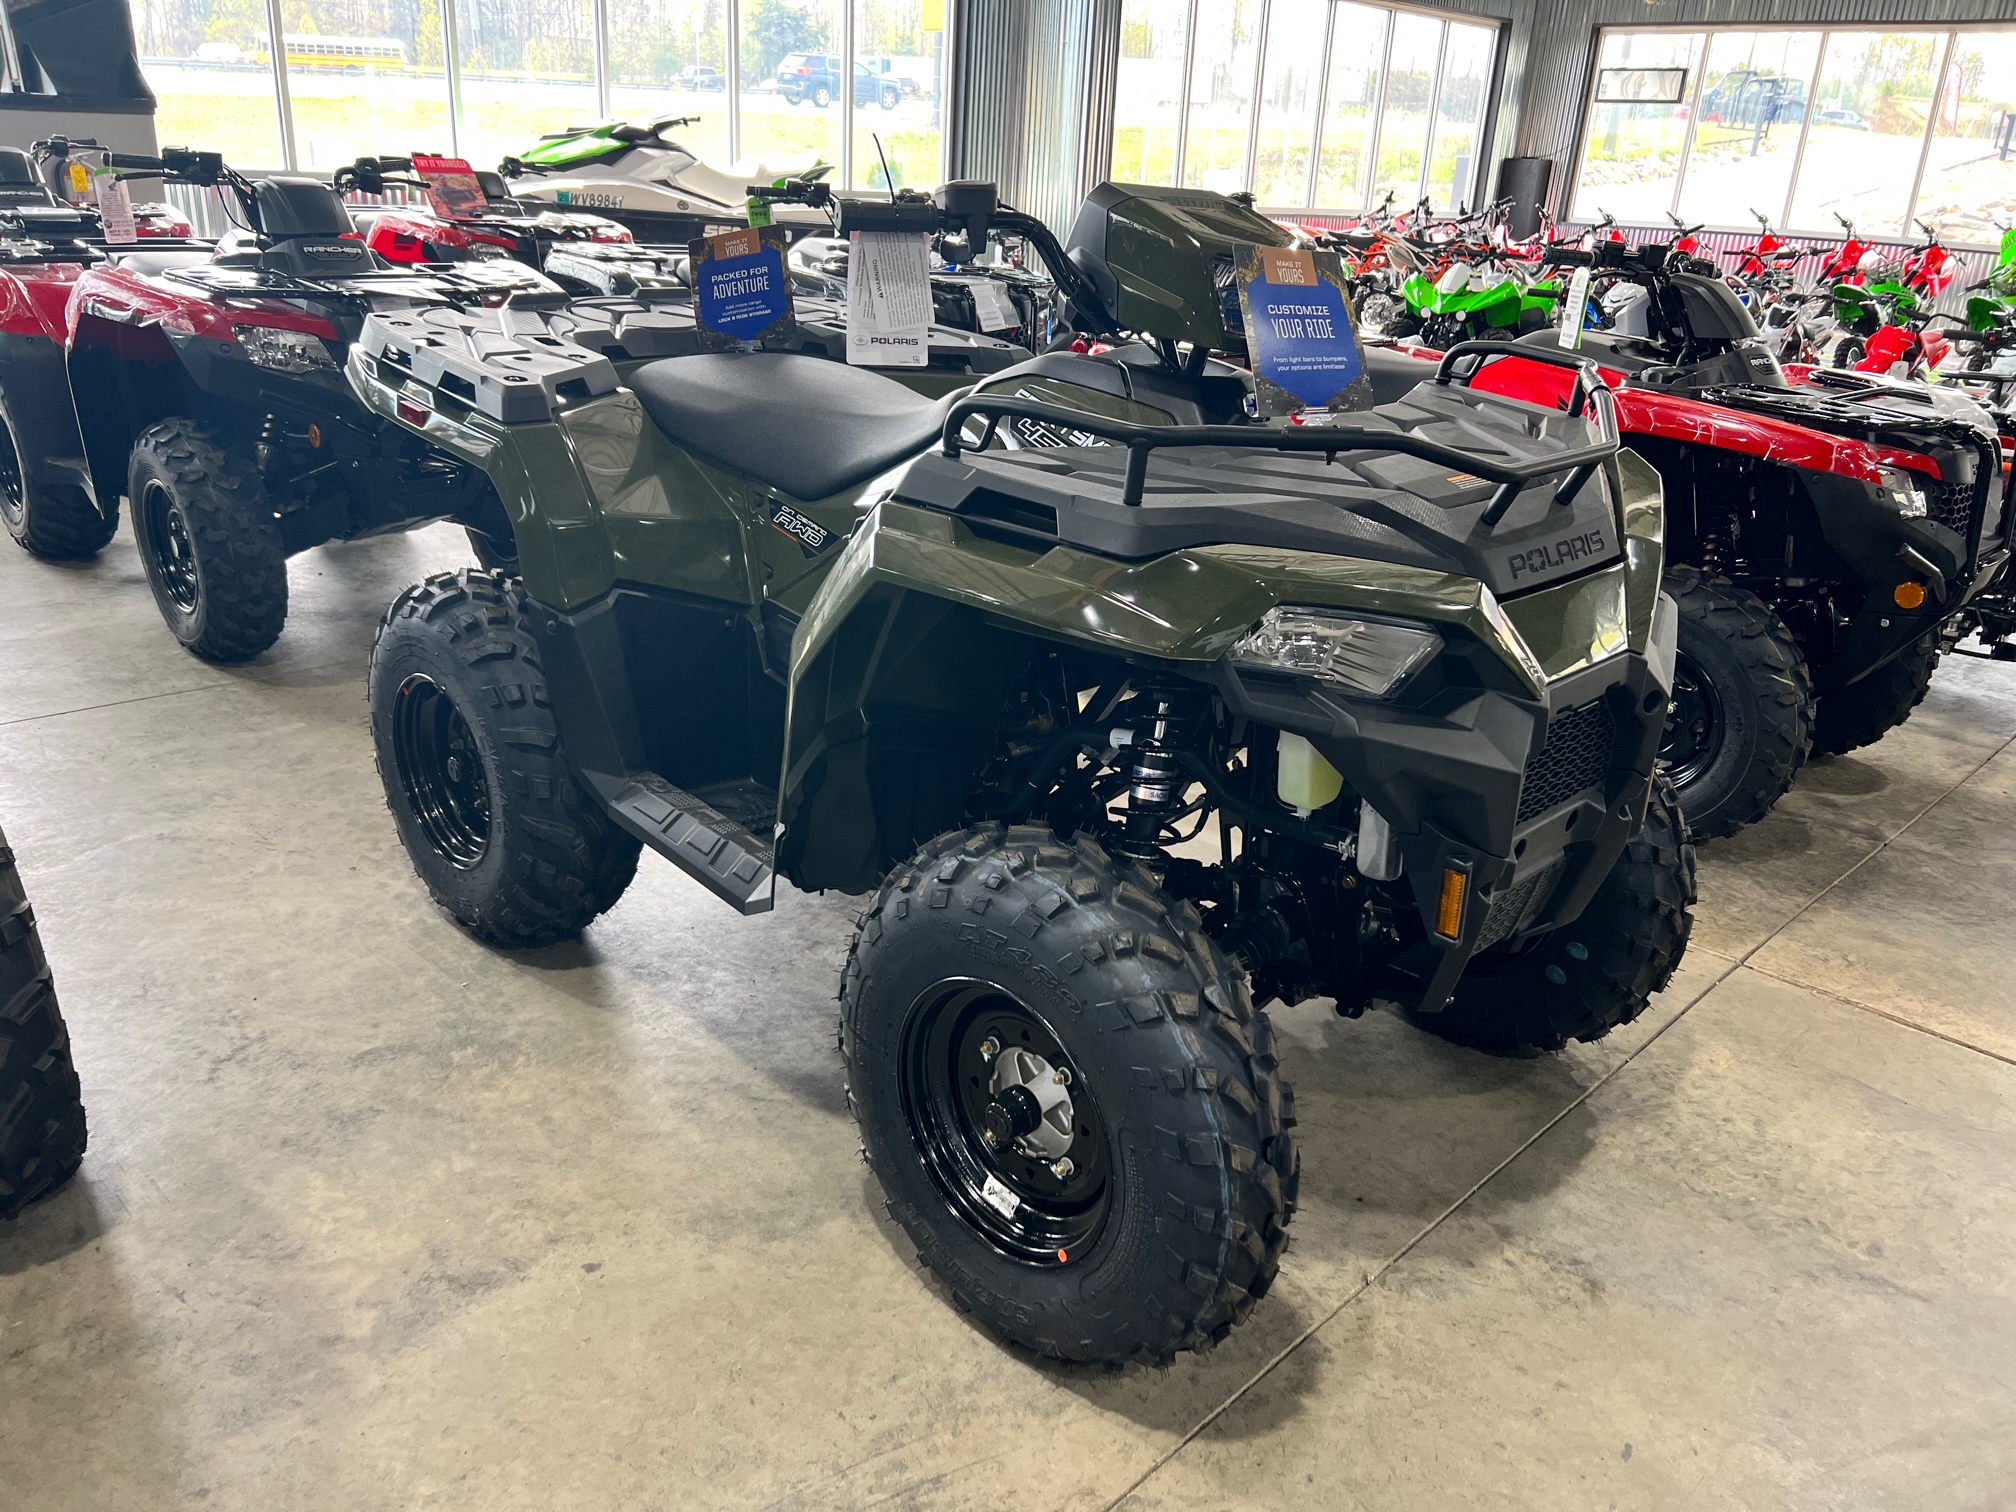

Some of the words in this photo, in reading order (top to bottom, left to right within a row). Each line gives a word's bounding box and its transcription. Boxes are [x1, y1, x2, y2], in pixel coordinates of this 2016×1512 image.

[437, 160, 468, 168] YOURSELF
[303, 246, 362, 255] RANCHER
[724, 239, 740, 247] MAKE
[724, 243, 749, 257] YOURS
[1276, 260, 1294, 268] MAKE
[711, 269, 748, 283] PACKED
[750, 266, 769, 276] FOR
[872, 259, 884, 293] WARNING
[1277, 267, 1305, 284] YOURS
[713, 275, 770, 300] ADVENTURE
[1267, 304, 1330, 315] CUSTOMIZE
[1270, 318, 1305, 339] YOUR
[1305, 318, 1336, 339] RIDE
[870, 337, 919, 345] POLARIS
[1289, 356, 1301, 364] light
[1323, 356, 1348, 364] bumpers,
[1291, 364, 1312, 372] options
[1018, 418, 1067, 448] 45
[773, 511, 824, 547] AWD
[796, 514, 828, 537] DEMAND
[1507, 529, 1605, 580] POLARIS
